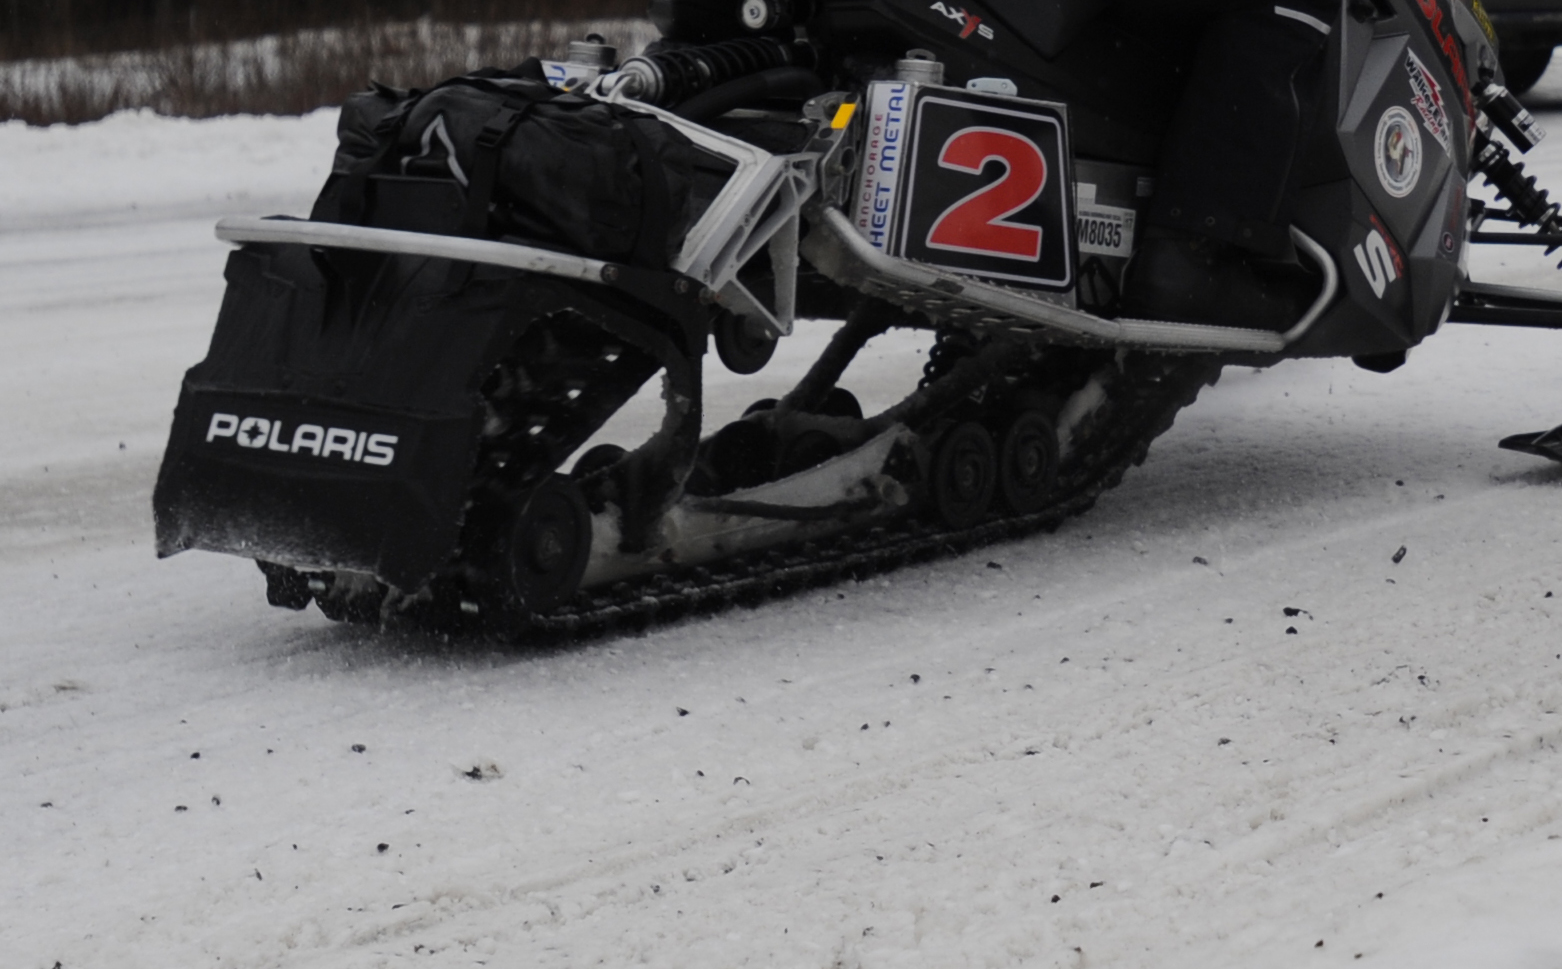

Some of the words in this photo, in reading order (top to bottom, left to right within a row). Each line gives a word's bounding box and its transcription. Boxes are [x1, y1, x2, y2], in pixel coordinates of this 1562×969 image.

[930, 1, 994, 39] AXYS
[859, 114, 882, 228] ANCHORAGE
[869, 186, 891, 248] HEET
[880, 83, 907, 173] METAL
[926, 126, 1047, 263] 2
[205, 412, 399, 466] POLARIS
